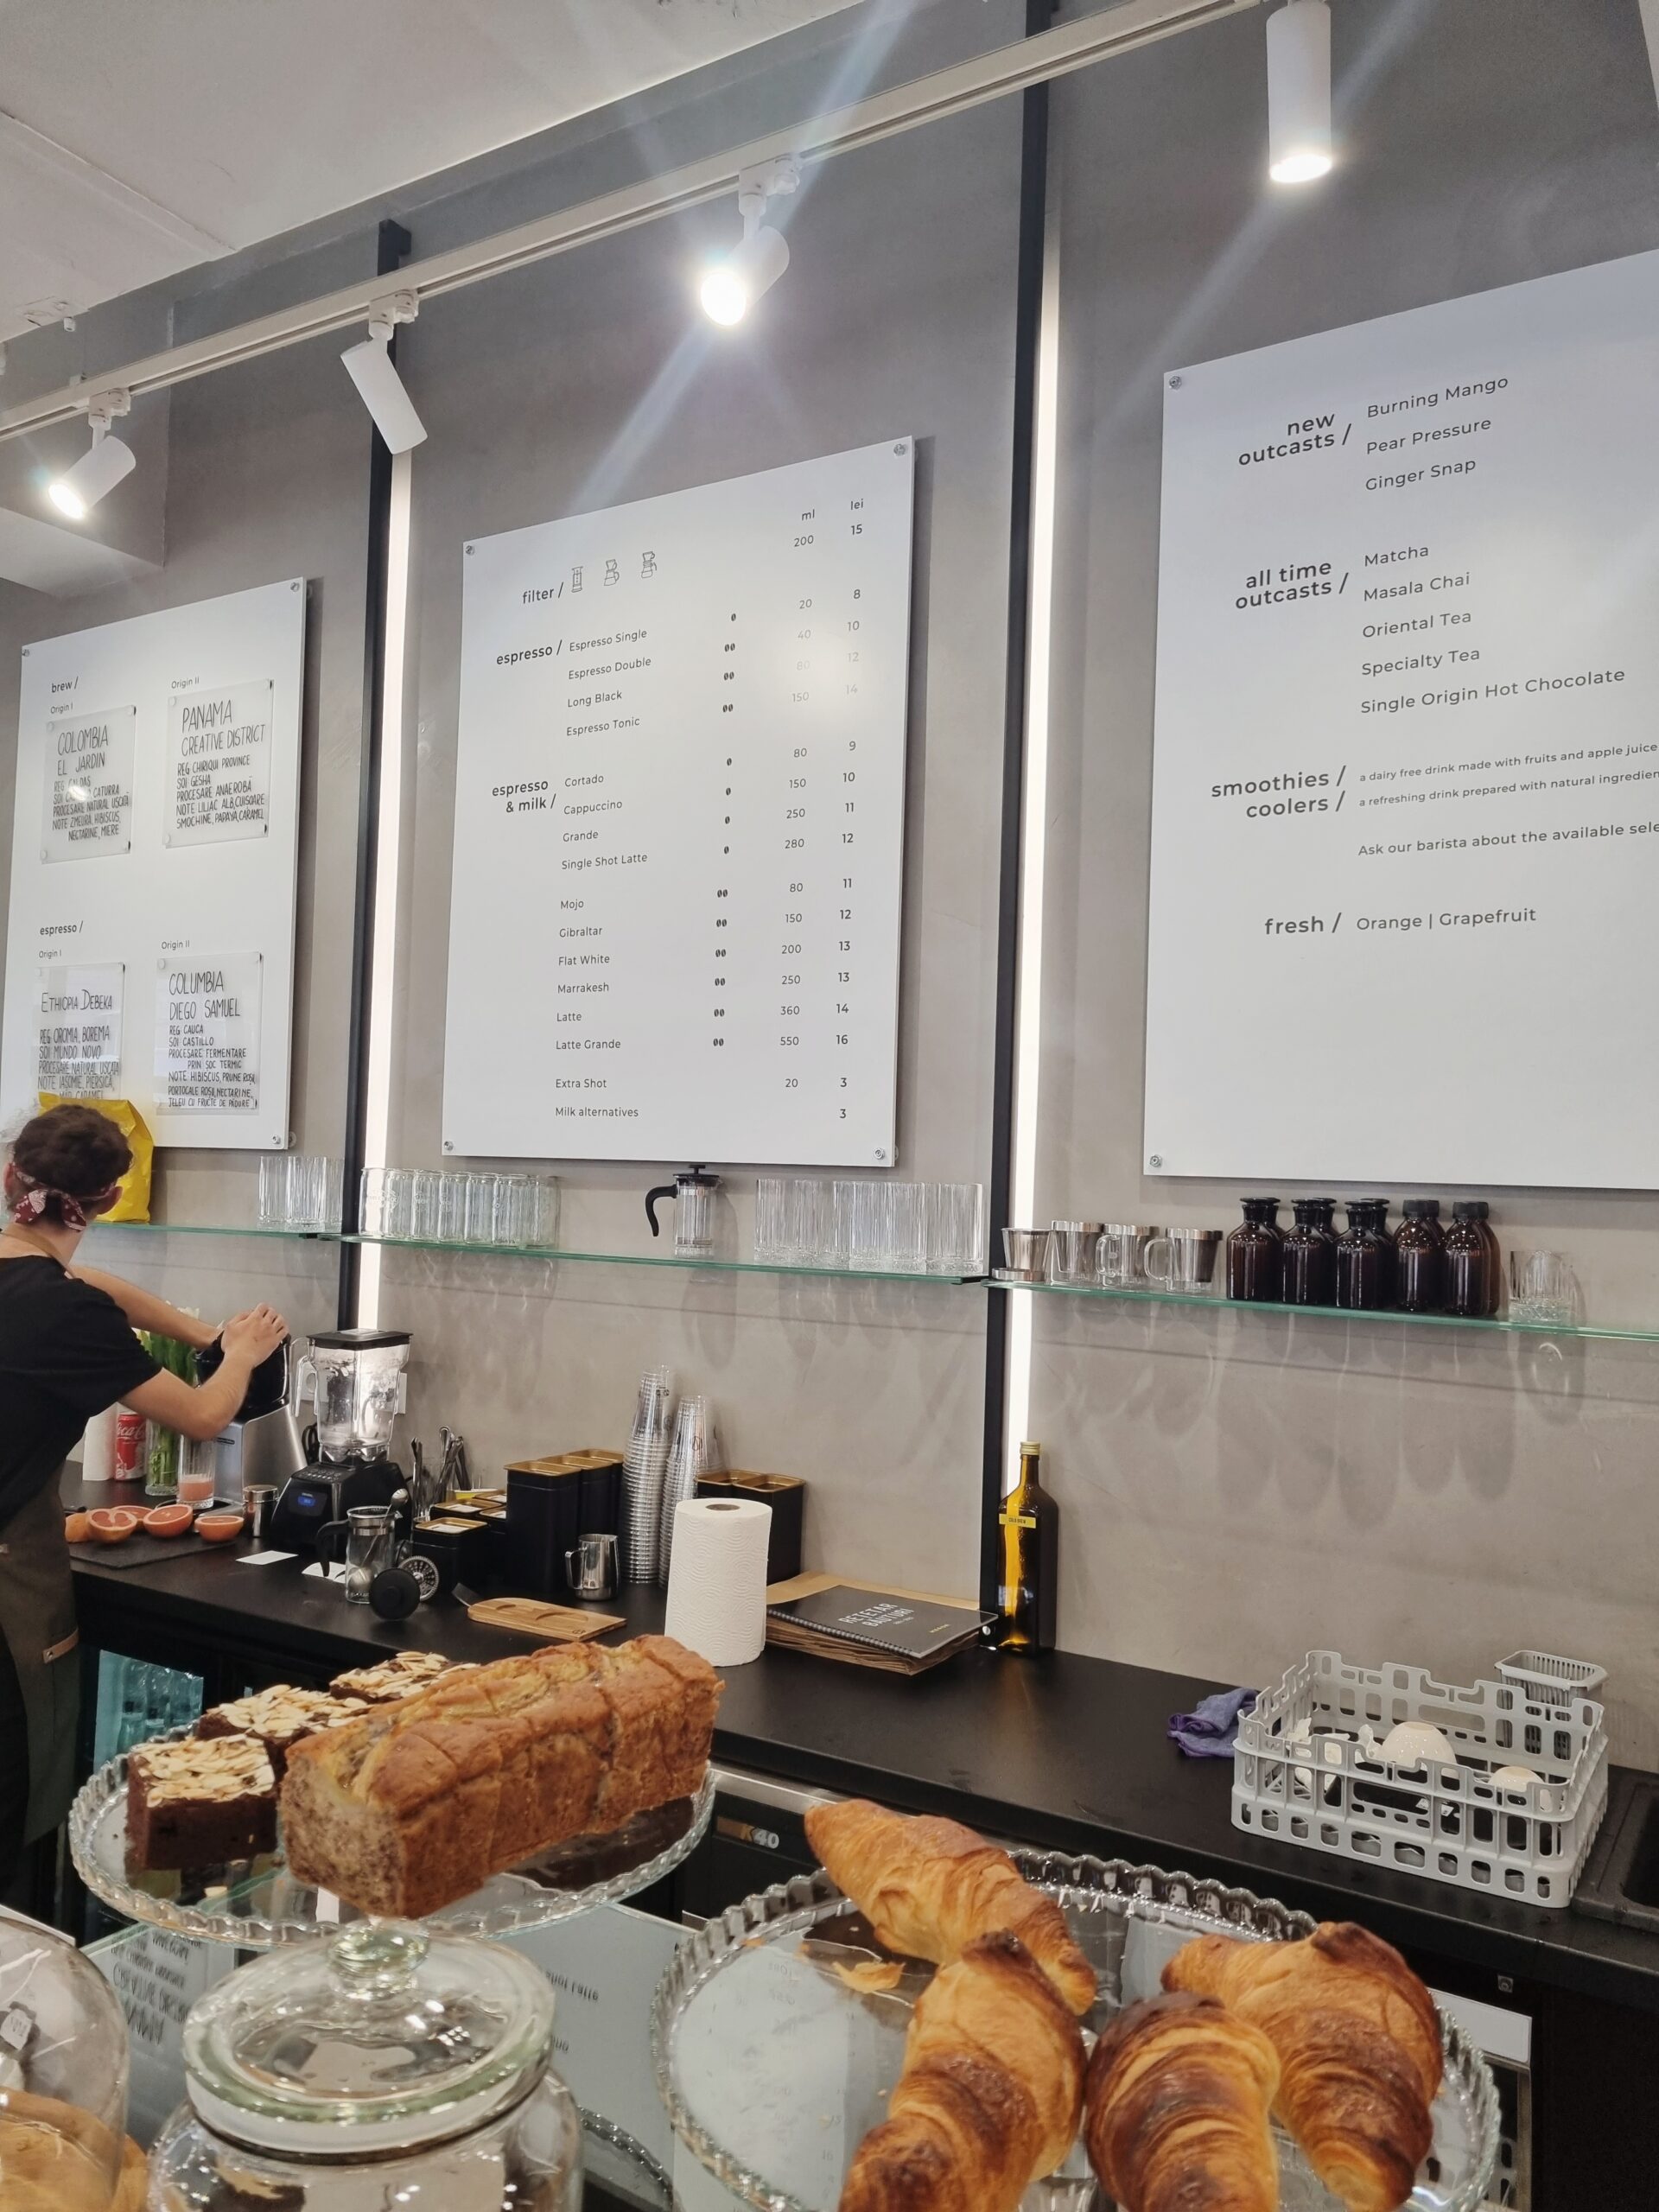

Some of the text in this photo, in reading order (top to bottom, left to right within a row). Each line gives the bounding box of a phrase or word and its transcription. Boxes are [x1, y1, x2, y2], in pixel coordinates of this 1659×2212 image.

[1368, 378, 1508, 418] Burning Mango
[1287, 414, 1335, 435] new
[1367, 420, 1491, 454] Pear Pressure
[1239, 434, 1335, 466] outcasts
[1365, 461, 1476, 490] Ginger Snap
[802, 499, 863, 521] ml lei
[794, 524, 862, 547] 200 15
[1364, 546, 1428, 567] Matcha
[1246, 563, 1332, 588] all time
[1364, 572, 1470, 601] Masala Chai
[523, 588, 554, 604] filter
[1236, 580, 1332, 609] outcasts
[569, 589, 861, 652] Espresso Single 20 8
[1363, 613, 1471, 638] Oriental Tea
[497, 646, 553, 665] espresso
[569, 620, 860, 680] Espresso Double 40 10
[1362, 650, 1479, 677] Specialty Tea
[51, 681, 73, 693] brew
[171, 677, 193, 689] Origin
[1361, 671, 1624, 714] Single Origin Hot Chocolate
[50, 703, 69, 715] Origin
[568, 697, 592, 708] Long
[595, 690, 622, 703] Black
[182, 699, 232, 734] PANAMA
[567, 691, 810, 737] Espresso Tonic 150
[57, 725, 109, 756] COLOMBIA
[181, 724, 265, 756] CREATIVE DISTRICT
[57, 752, 105, 776] EL JARDIN
[177, 754, 251, 776] REG CHIRIQUI PROVINCE
[564, 741, 856, 787] Cortado 80 9
[1369, 771, 1396, 780] dairy
[1400, 768, 1421, 778] free
[1425, 764, 1455, 774] drink
[1459, 760, 1491, 772] made
[1495, 757, 1521, 767] with
[1525, 753, 1557, 765] fruits
[1560, 750, 1584, 760] and
[1587, 747, 1623, 760] apple
[1625, 743, 1658, 756] juice
[191, 774, 211, 786] GESHA
[493, 781, 549, 798] espresso
[1211, 772, 1329, 798] smoothies
[1369, 793, 1426, 805] refreshing
[1429, 789, 1459, 800] drink
[1462, 783, 1516, 798] prepared
[1520, 780, 1547, 791] with
[1551, 775, 1595, 788] natural
[505, 797, 546, 813] & milk
[563, 772, 855, 816] Cappuccino 150 10
[1246, 798, 1328, 818] coolers
[563, 802, 854, 842] Grande 250 11
[562, 833, 854, 870] Single Shot Latte 280 12
[1358, 843, 1383, 855] Ask
[1388, 843, 1412, 854] our
[1417, 838, 1466, 851] barista
[1471, 834, 1516, 847] about
[1521, 831, 1548, 842] the
[1553, 824, 1624, 841] available
[561, 878, 852, 911] Mojo 80 11
[40, 923, 77, 937] espresso
[559, 909, 851, 938] Gibraltar 150 12
[1265, 908, 1536, 935] fresh Orange Grapefruit
[39, 950, 58, 959] Origin
[162, 941, 183, 950] Origin
[558, 941, 850, 966] Flat White 200 13
[168, 970, 224, 996] COLUMBIA
[558, 972, 849, 994] Marrakesh 250 13
[169, 998, 240, 1021] DIEGO SAMUEL
[556, 1003, 849, 1022] Latte 360 14
[169, 1024, 203, 1035] REG CAUCA
[183, 1037, 213, 1046] CASTILLO
[53, 1046, 77, 1059] MUNDO
[81, 1045, 101, 1059] NOVO
[168, 1048, 246, 1058] PROCESARE FERMENTARE
[556, 1034, 849, 1050] Latte Grande 550 16
[556, 1077, 847, 1088] Extra Shot 20 3
[556, 1106, 846, 1119] Milk alternatives 3
